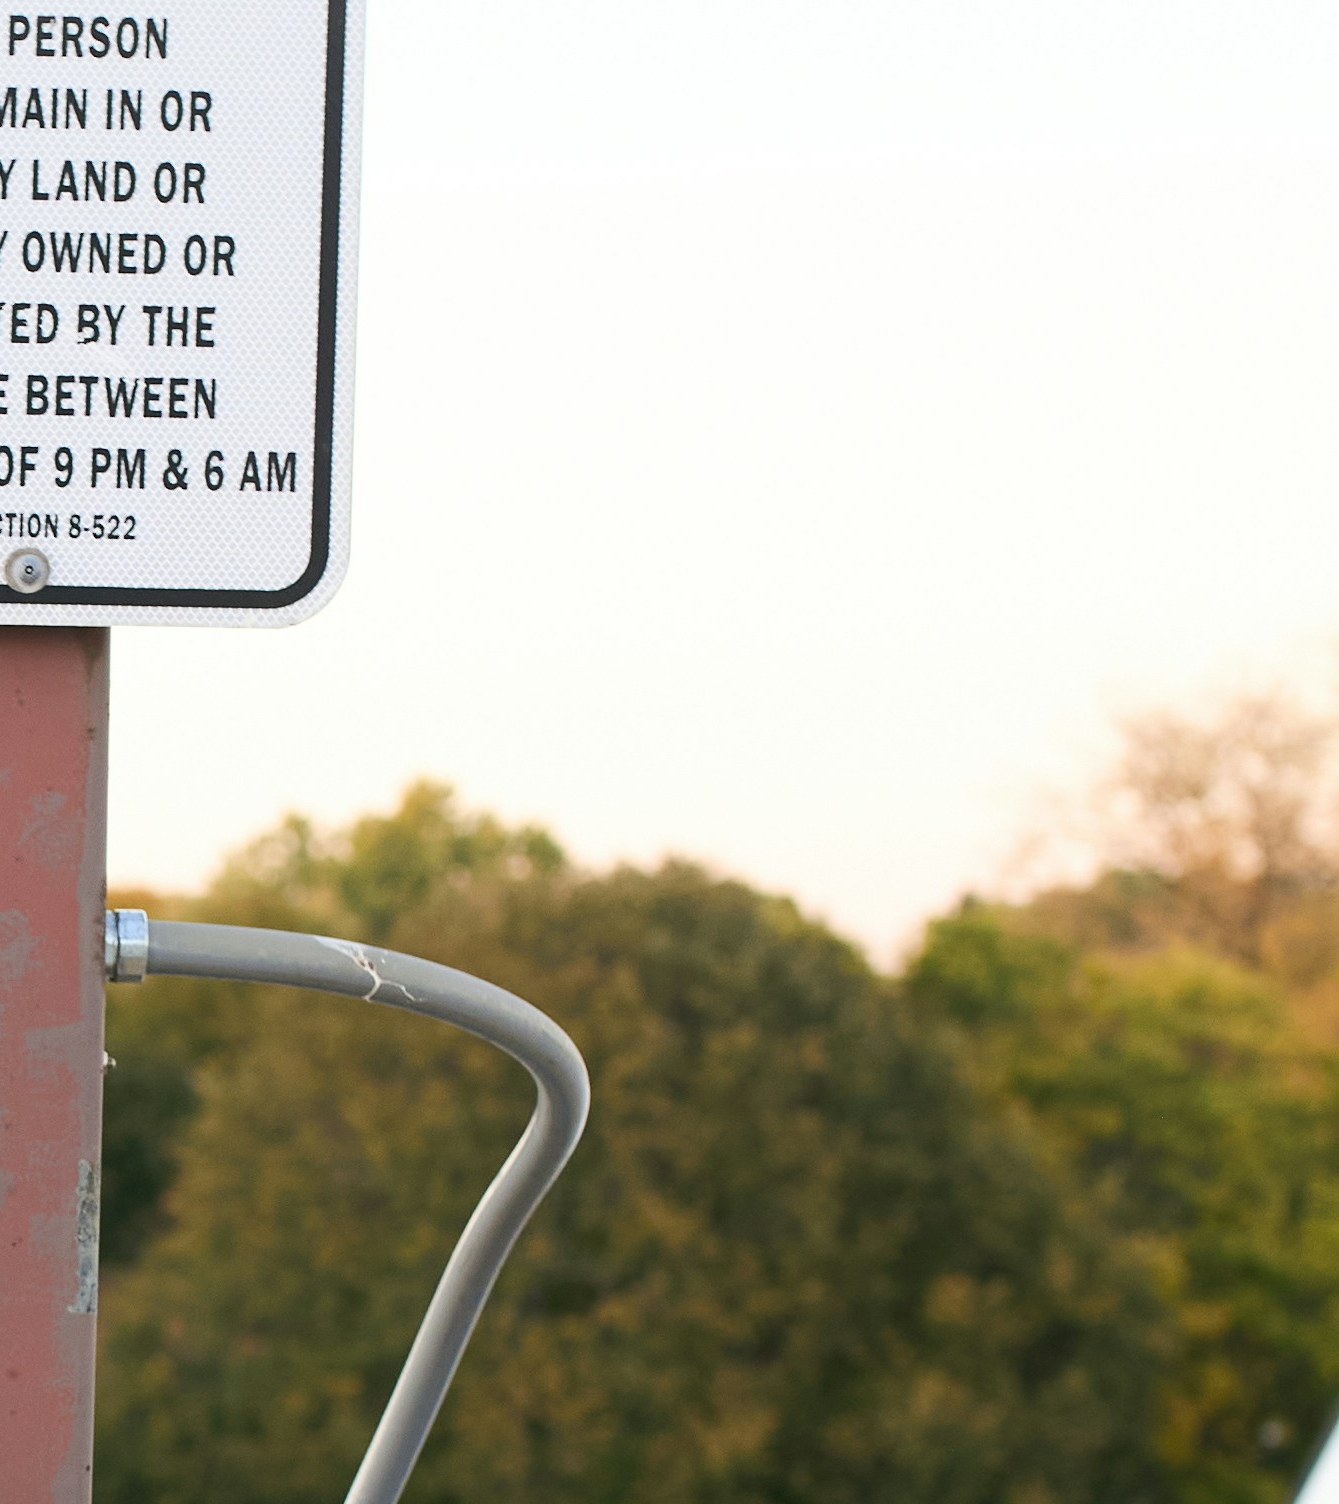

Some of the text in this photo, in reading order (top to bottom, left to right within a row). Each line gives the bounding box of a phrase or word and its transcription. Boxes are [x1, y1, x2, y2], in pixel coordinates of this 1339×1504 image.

[8, 14, 168, 60] PERSON
[105, 88, 142, 131] IN
[160, 89, 213, 133] OR
[31, 159, 137, 203] LAND
[153, 161, 206, 204] OR
[22, 230, 167, 275] OWNED
[183, 234, 236, 277] OR
[76, 303, 126, 346] BY
[142, 305, 216, 348] THE
[26, 374, 217, 420] BETWEEN
[54, 446, 74, 488] 9
[90, 447, 146, 490] PM
[162, 448, 189, 491] &
[204, 450, 225, 492] 6
[238, 450, 297, 493] AM
[68, 513, 137, 540] 8-522
